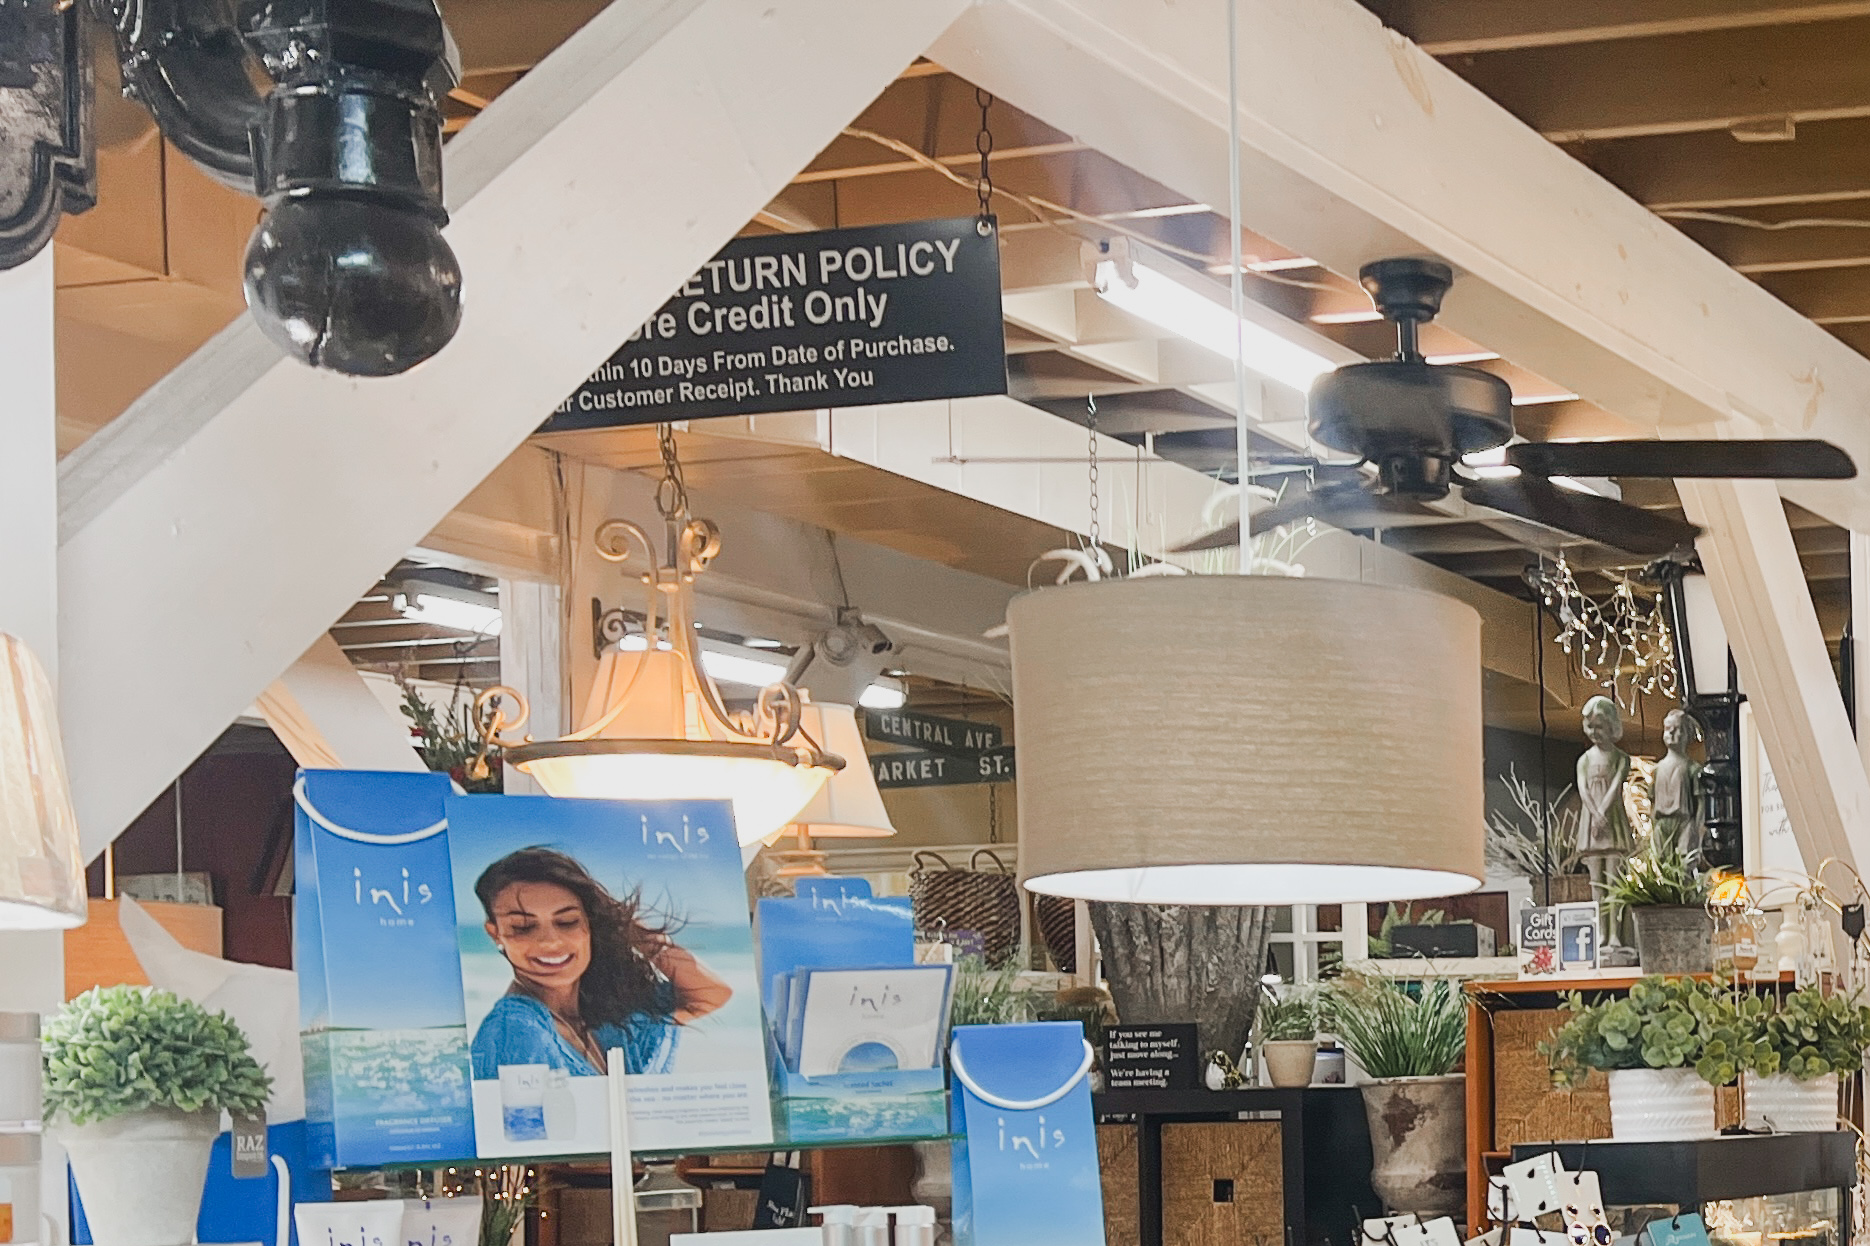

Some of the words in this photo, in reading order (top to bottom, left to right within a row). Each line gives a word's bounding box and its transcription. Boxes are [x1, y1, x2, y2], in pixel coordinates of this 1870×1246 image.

[818, 238, 961, 284] POLICY
[687, 295, 793, 333] Credit
[804, 287, 888, 328] Only
[629, 353, 652, 379] 10
[658, 349, 707, 380] Days
[713, 346, 767, 371] From
[772, 341, 818, 367] Date
[823, 339, 845, 361] of
[851, 334, 956, 359] Purchase.
[578, 383, 674, 411] Customer
[680, 376, 760, 405] Receipt.
[765, 372, 828, 396] Thank
[833, 367, 875, 389] You
[880, 714, 953, 746] CENTRAL
[965, 729, 994, 750] AVE
[979, 755, 1011, 777] ST.
[640, 814, 710, 853] inis
[354, 867, 432, 915] inis
[379, 917, 414, 927] home
[1529, 913, 1553, 928] Gift
[850, 985, 902, 1012] inis
[1109, 1030, 1116, 1039] If
[1118, 1031, 1133, 1042] you
[1109, 1040, 1139, 1050] talking
[1140, 1041, 1149, 1049] to
[1127, 1051, 1149, 1059] move
[1110, 1068, 1134, 1078] We're
[1135, 1068, 1163, 1080] having
[1164, 1069, 1170, 1077] a
[1110, 1079, 1132, 1087] team
[236, 1134, 264, 1151] RAZ
[997, 1115, 1065, 1159] inis
